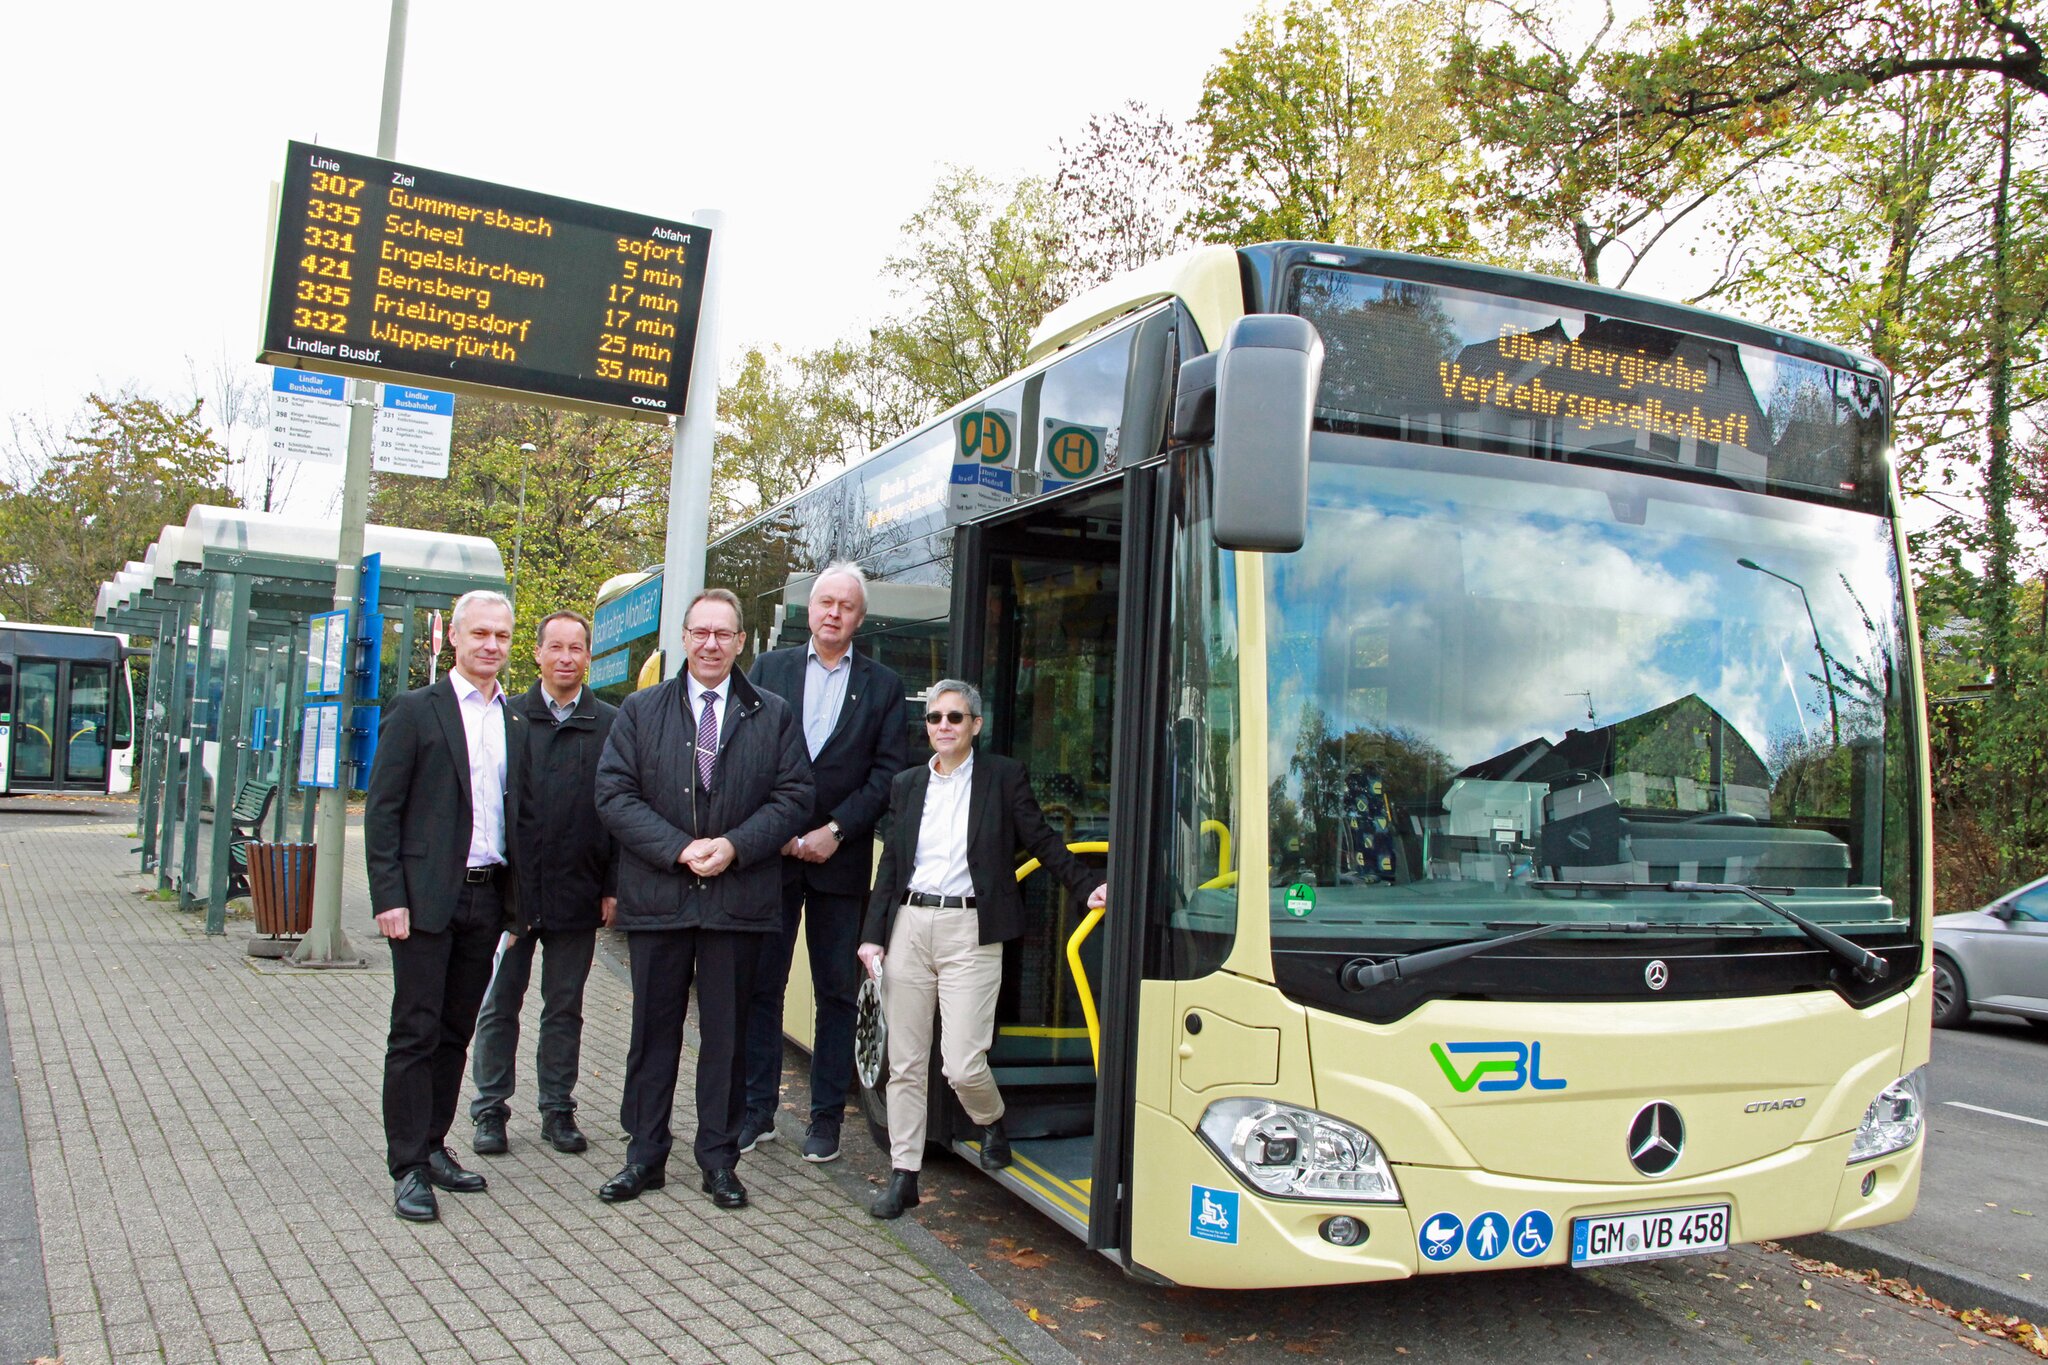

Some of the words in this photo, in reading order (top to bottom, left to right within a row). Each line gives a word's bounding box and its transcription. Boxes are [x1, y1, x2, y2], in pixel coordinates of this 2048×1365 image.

[310, 155, 340, 172] Linie
[311, 171, 365, 198] 307
[392, 172, 415, 187] Ziel
[308, 199, 362, 226] 335
[389, 187, 552, 237] Gummersbach
[304, 226, 356, 253] 331
[385, 214, 464, 246] Scheel
[652, 226, 691, 244] Abfahrt
[381, 240, 545, 288] Engelskirchen
[617, 238, 685, 264] sofort
[300, 254, 352, 280] 421
[623, 260, 638, 279] 5
[643, 268, 682, 289] min
[297, 280, 351, 307] 335
[378, 267, 490, 309] Bensberg
[608, 284, 634, 303] 17
[639, 293, 679, 313] min
[294, 307, 348, 334] 332
[374, 294, 531, 342] Frielingsdorf
[605, 309, 631, 328] 17
[635, 317, 675, 338] min
[287, 336, 336, 355] Lindlar
[339, 344, 382, 363] Busbf.
[371, 320, 515, 362] Wipperfürth
[599, 333, 627, 354] 25
[632, 342, 671, 363] min
[1499, 323, 1707, 393] Oberbergische
[299, 374, 324, 385] Lindlar
[595, 358, 623, 379] 35
[628, 366, 668, 387] min
[289, 383, 332, 396] Busbahnhof
[404, 391, 429, 401] Lindlar
[632, 396, 667, 408] OVAG
[395, 399, 437, 411] Busbahnhof
[1440, 361, 1749, 447] Verkehrsgesellschaft
[1296, 885, 1305, 900] 4
[1429, 1041, 1567, 1092] VBL
[1744, 1097, 1806, 1113] CITARO
[1577, 1245, 1584, 1254] D
[1590, 1222, 1624, 1255] GM
[1642, 1218, 1673, 1249] VB
[1678, 1212, 1724, 1244] 458
